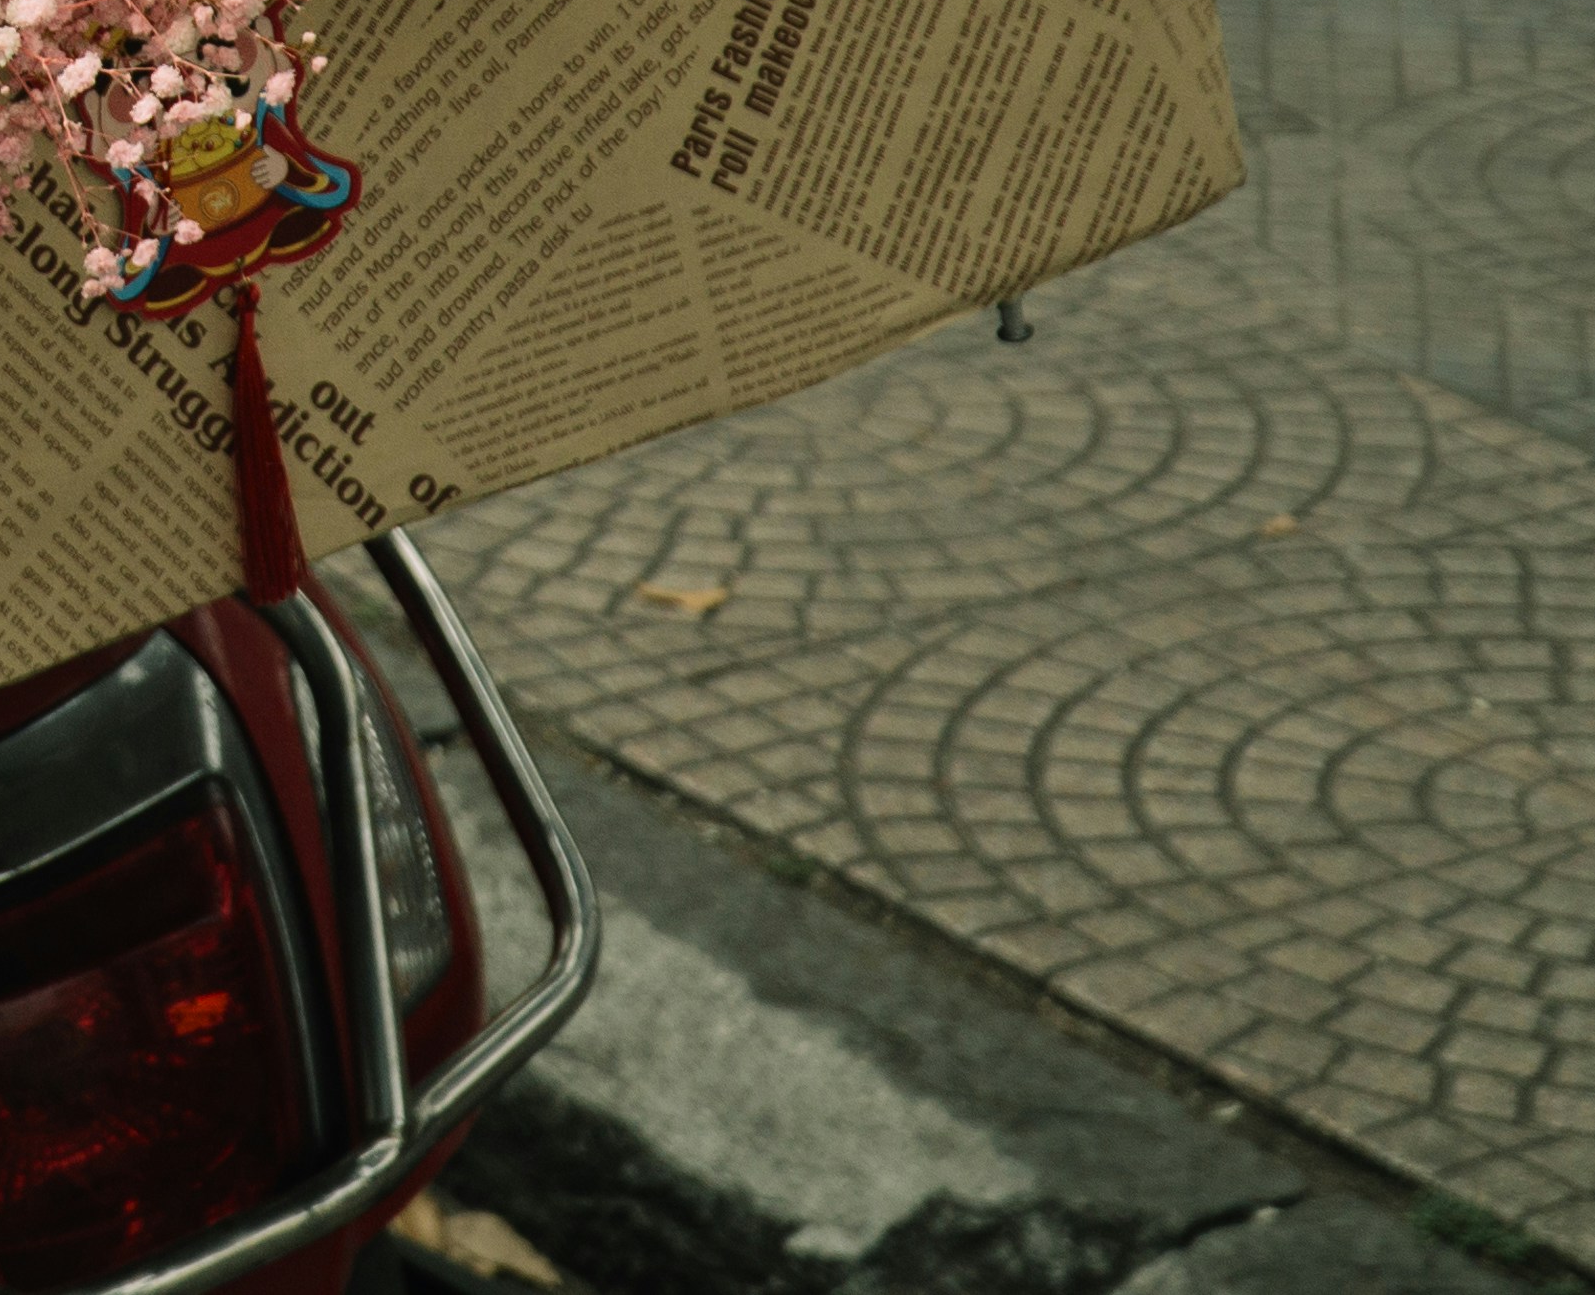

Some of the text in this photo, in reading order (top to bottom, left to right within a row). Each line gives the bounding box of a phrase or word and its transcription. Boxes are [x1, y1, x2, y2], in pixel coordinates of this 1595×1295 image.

[377, 86, 441, 151] nothing
[438, 68, 458, 88] in
[454, 37, 486, 70] the
[490, 1, 523, 35] ner.
[380, 93, 396, 110] a
[392, 30, 456, 94] favorite
[383, 156, 406, 185] all
[404, 123, 442, 165] yers
[448, 82, 482, 115] live
[480, 55, 510, 84] oil,
[668, 86, 732, 179] Paris
[333, 324, 366, 353] ick
[364, 297, 384, 325] of
[383, 270, 415, 302] the
[412, 195, 486, 271] Day-only
[483, 163, 518, 197] this
[515, 114, 564, 163] horse
[562, 64, 611, 115] threw
[611, 39, 635, 66] its
[634, 0, 678, 42] rider,
[364, 229, 419, 282] Mood,
[416, 187, 457, 230] once
[455, 129, 509, 192] picked
[506, 119, 522, 136] a
[516, 73, 566, 122] horse
[562, 53, 585, 75] to
[583, 21, 621, 54] win.
[396, 297, 427, 330] ran
[424, 263, 460, 299] into
[456, 233, 488, 265] the
[487, 144, 573, 235] decora-tive
[572, 89, 622, 146] infield
[618, 58, 662, 95] lake,
[660, 22, 690, 58] got
[709, 126, 759, 196] roll
[331, 241, 364, 282] and
[362, 201, 409, 247] drow.
[403, 323, 437, 363] and
[436, 250, 511, 328] drowned.
[506, 214, 544, 247] The
[541, 178, 579, 215] Pick
[578, 152, 598, 179] of
[596, 127, 628, 158] the
[624, 83, 663, 129] Day!
[393, 201, 593, 413] vorite pantry pasta disk tu
[310, 379, 461, 514] out of
